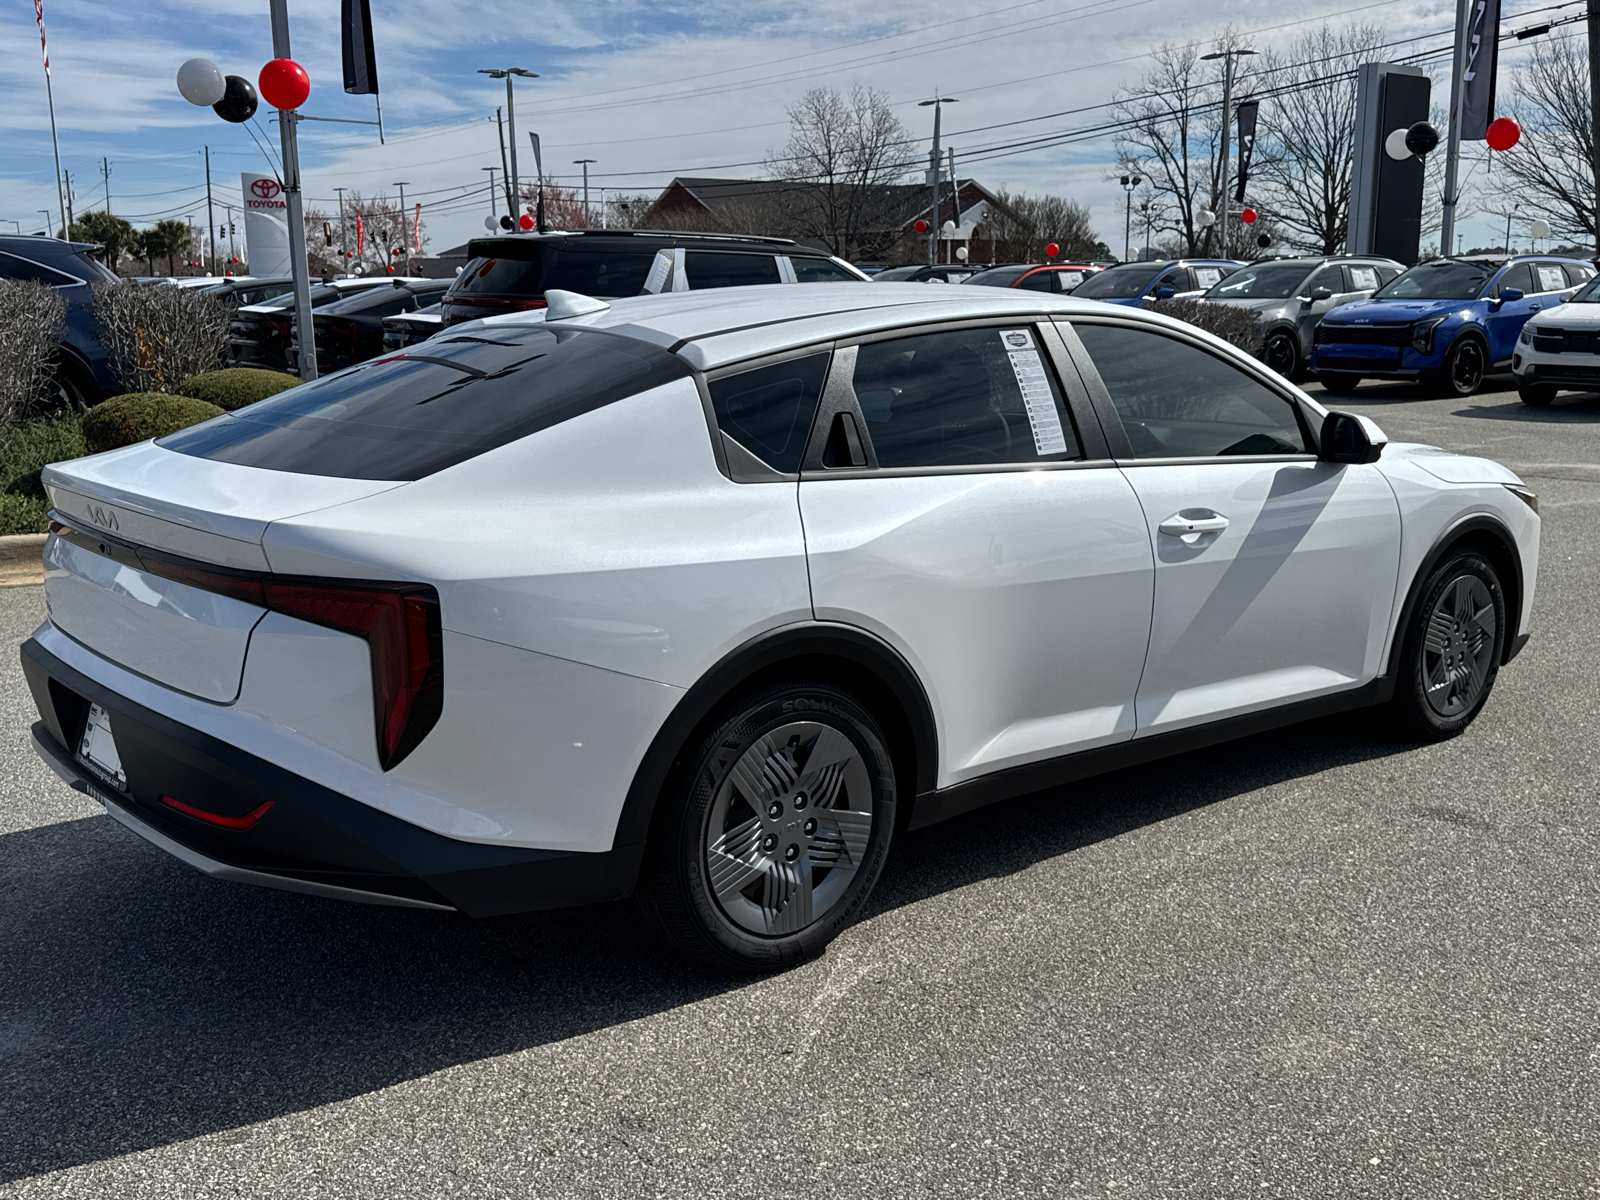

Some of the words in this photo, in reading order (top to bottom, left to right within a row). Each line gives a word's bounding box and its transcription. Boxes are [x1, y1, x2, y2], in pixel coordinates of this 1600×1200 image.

[246, 200, 287, 209] TOYOTA
[86, 504, 120, 532] KIA
[781, 698, 844, 716] SOLUS
[865, 842, 885, 884] 205/55
[851, 885, 868, 908] R16
[832, 908, 852, 930] 91H
